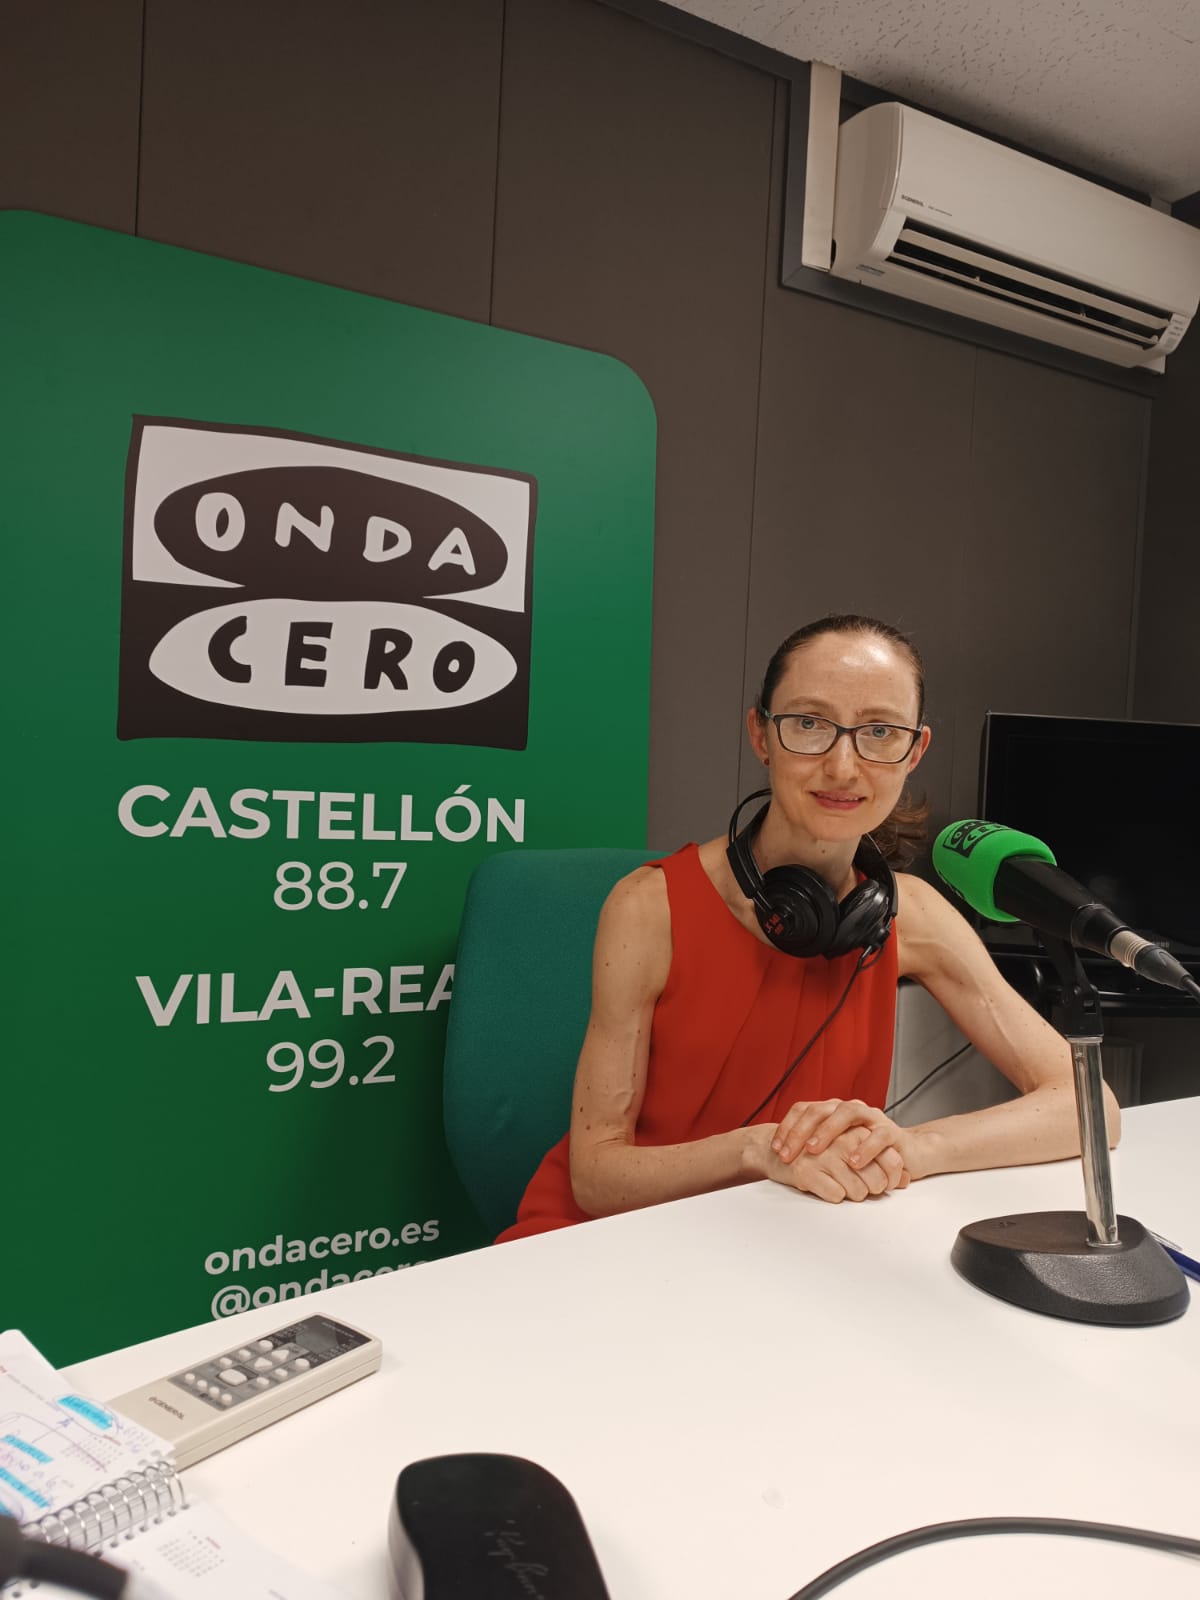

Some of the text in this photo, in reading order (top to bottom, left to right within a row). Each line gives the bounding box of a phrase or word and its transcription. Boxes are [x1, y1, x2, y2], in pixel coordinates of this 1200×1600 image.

[195, 492, 476, 576] ONDA
[208, 615, 476, 694] CERO
[117, 784, 526, 843] CASTELLÓN
[273, 861, 408, 911] 88.7
[266, 1035, 396, 1093] 99.2
[204, 1219, 440, 1275] ondacero.es
